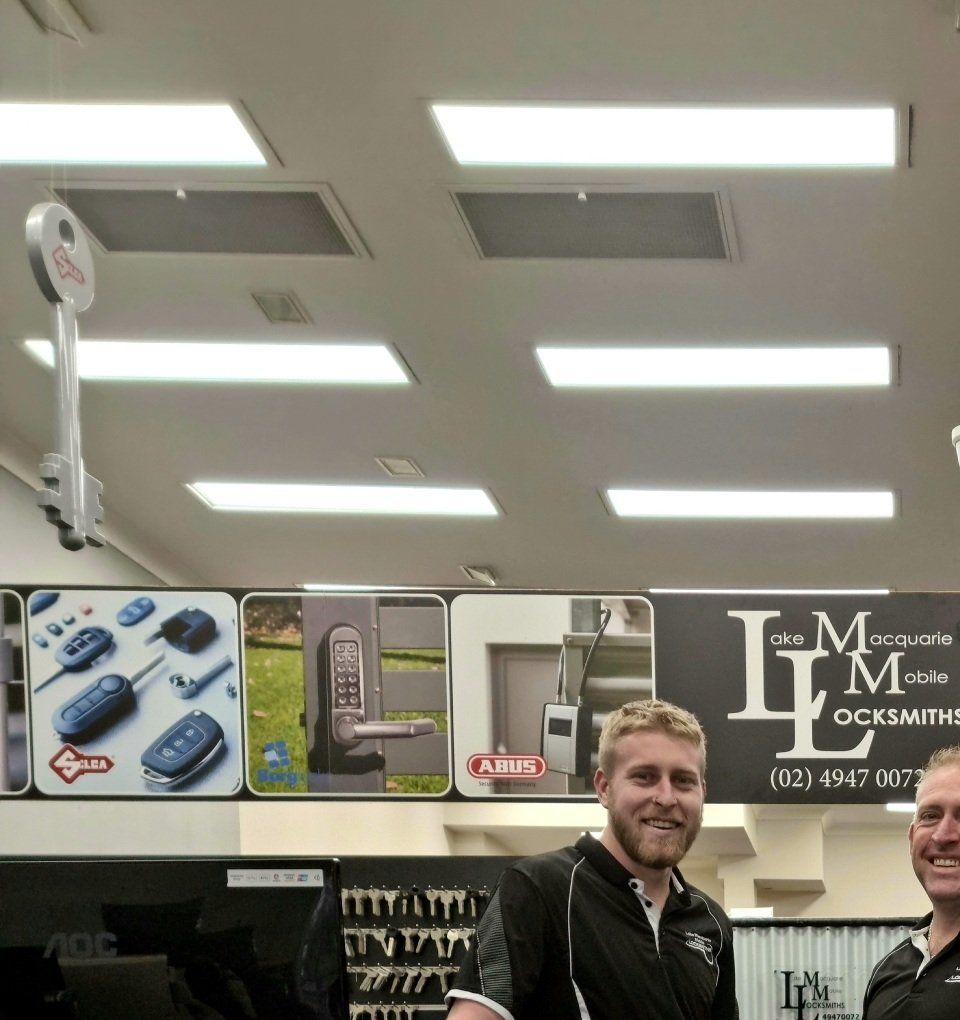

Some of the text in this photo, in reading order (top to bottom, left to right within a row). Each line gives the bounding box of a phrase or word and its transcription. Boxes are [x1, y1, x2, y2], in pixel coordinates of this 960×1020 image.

[478, 759, 537, 774] ABUS
[770, 766, 922, 791] (02) 4947 0072
[822, 1013, 860, 1020] 49470072
